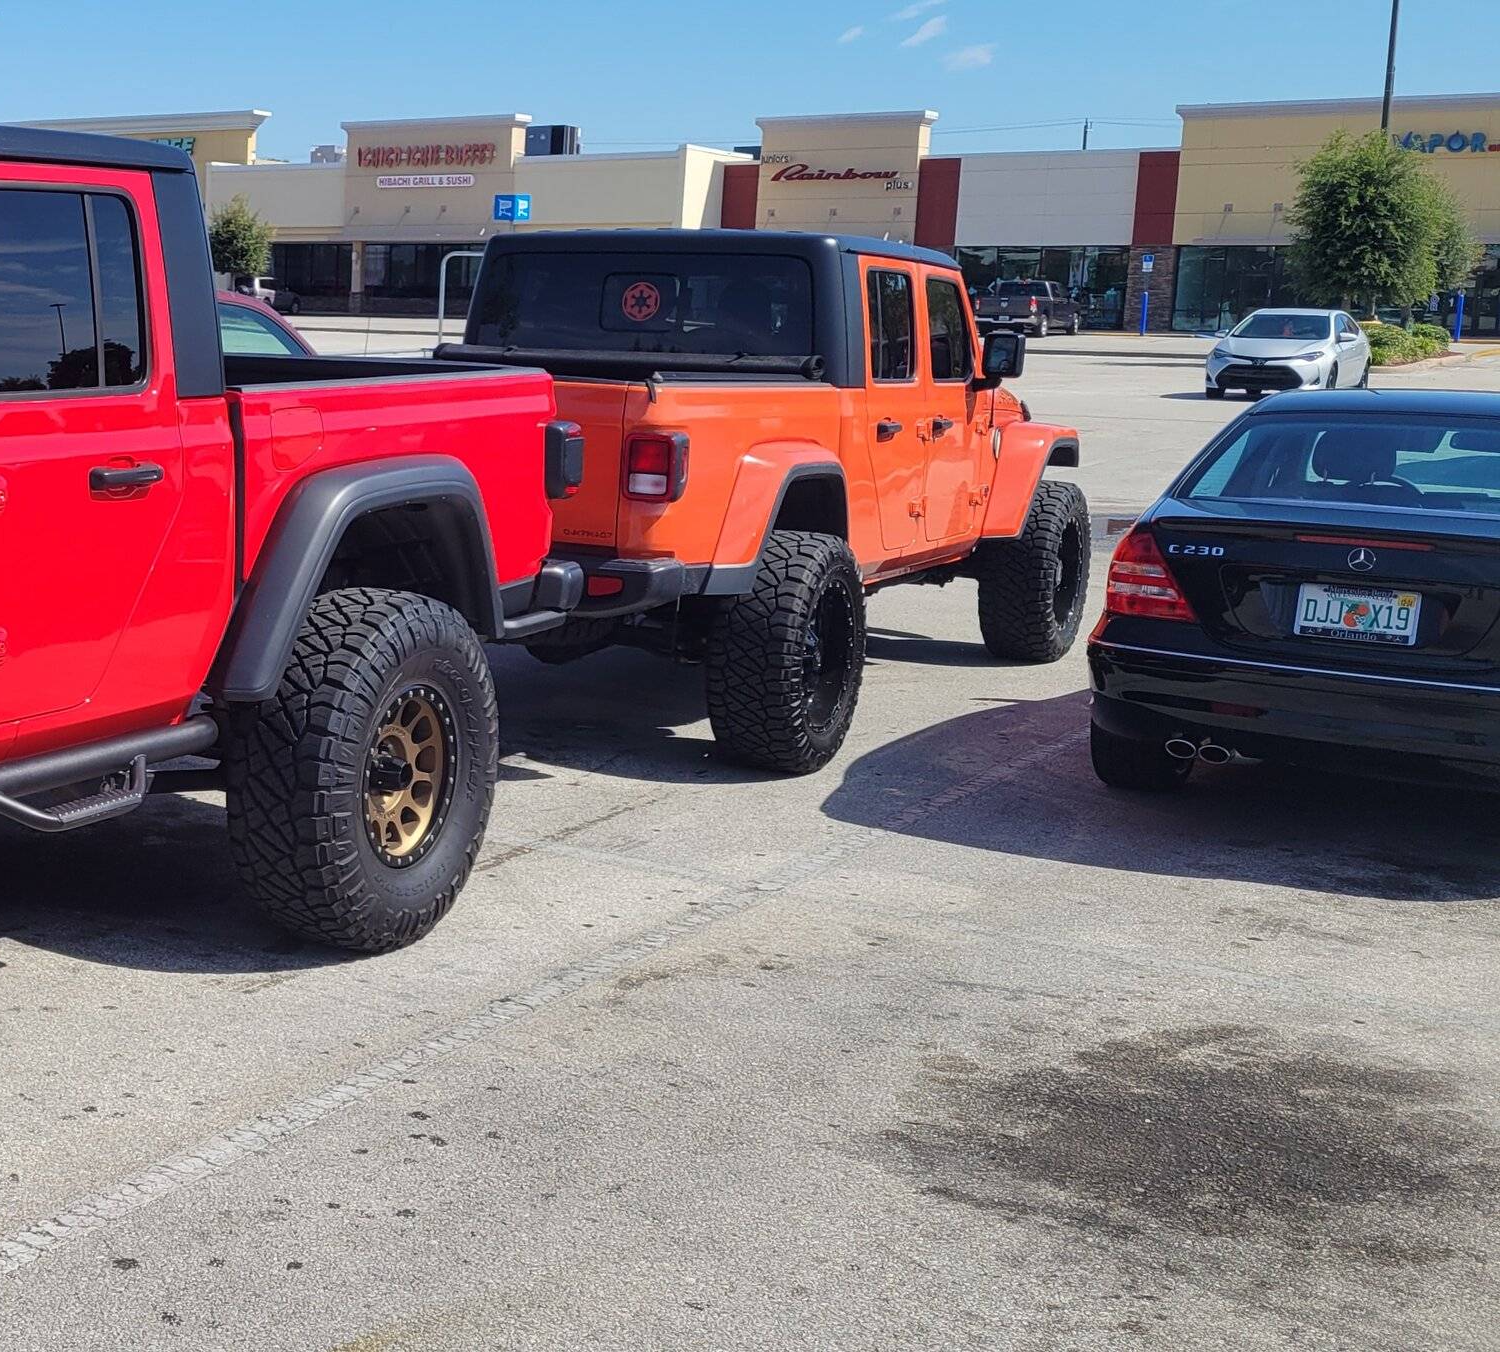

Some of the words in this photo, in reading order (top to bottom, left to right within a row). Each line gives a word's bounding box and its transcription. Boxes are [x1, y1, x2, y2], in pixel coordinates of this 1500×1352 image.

[771, 163, 899, 181] Rainbow
[379, 178, 411, 187] HIBACHI
[412, 177, 437, 186] GRILL
[447, 176, 471, 185] SUSHI
[885, 181, 909, 191] plus
[1168, 544, 1180, 554] C
[1183, 545, 1224, 556] 230
[1303, 598, 1345, 625] DJJ
[1369, 603, 1411, 631] X19
[1330, 629, 1378, 641] Orlando
